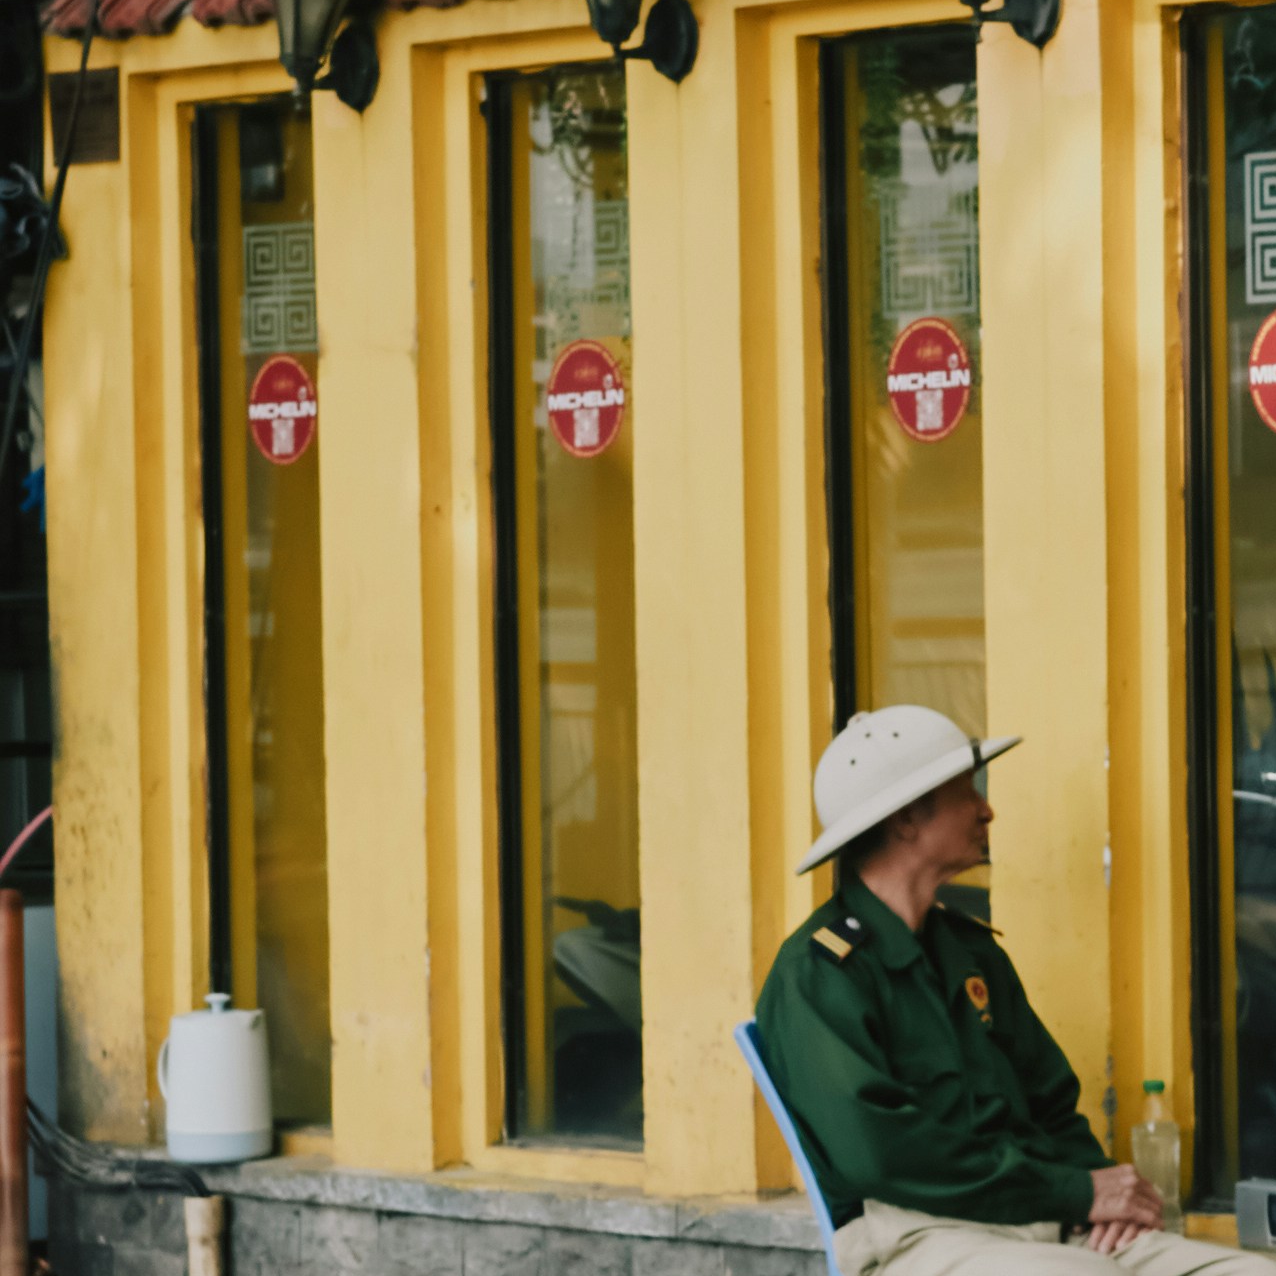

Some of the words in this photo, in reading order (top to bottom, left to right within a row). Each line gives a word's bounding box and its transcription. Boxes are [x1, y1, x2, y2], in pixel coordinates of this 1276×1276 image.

[887, 369, 970, 392] MICHELIN
[249, 400, 317, 420] MICHELIN
[548, 388, 624, 411] MICHELIN
